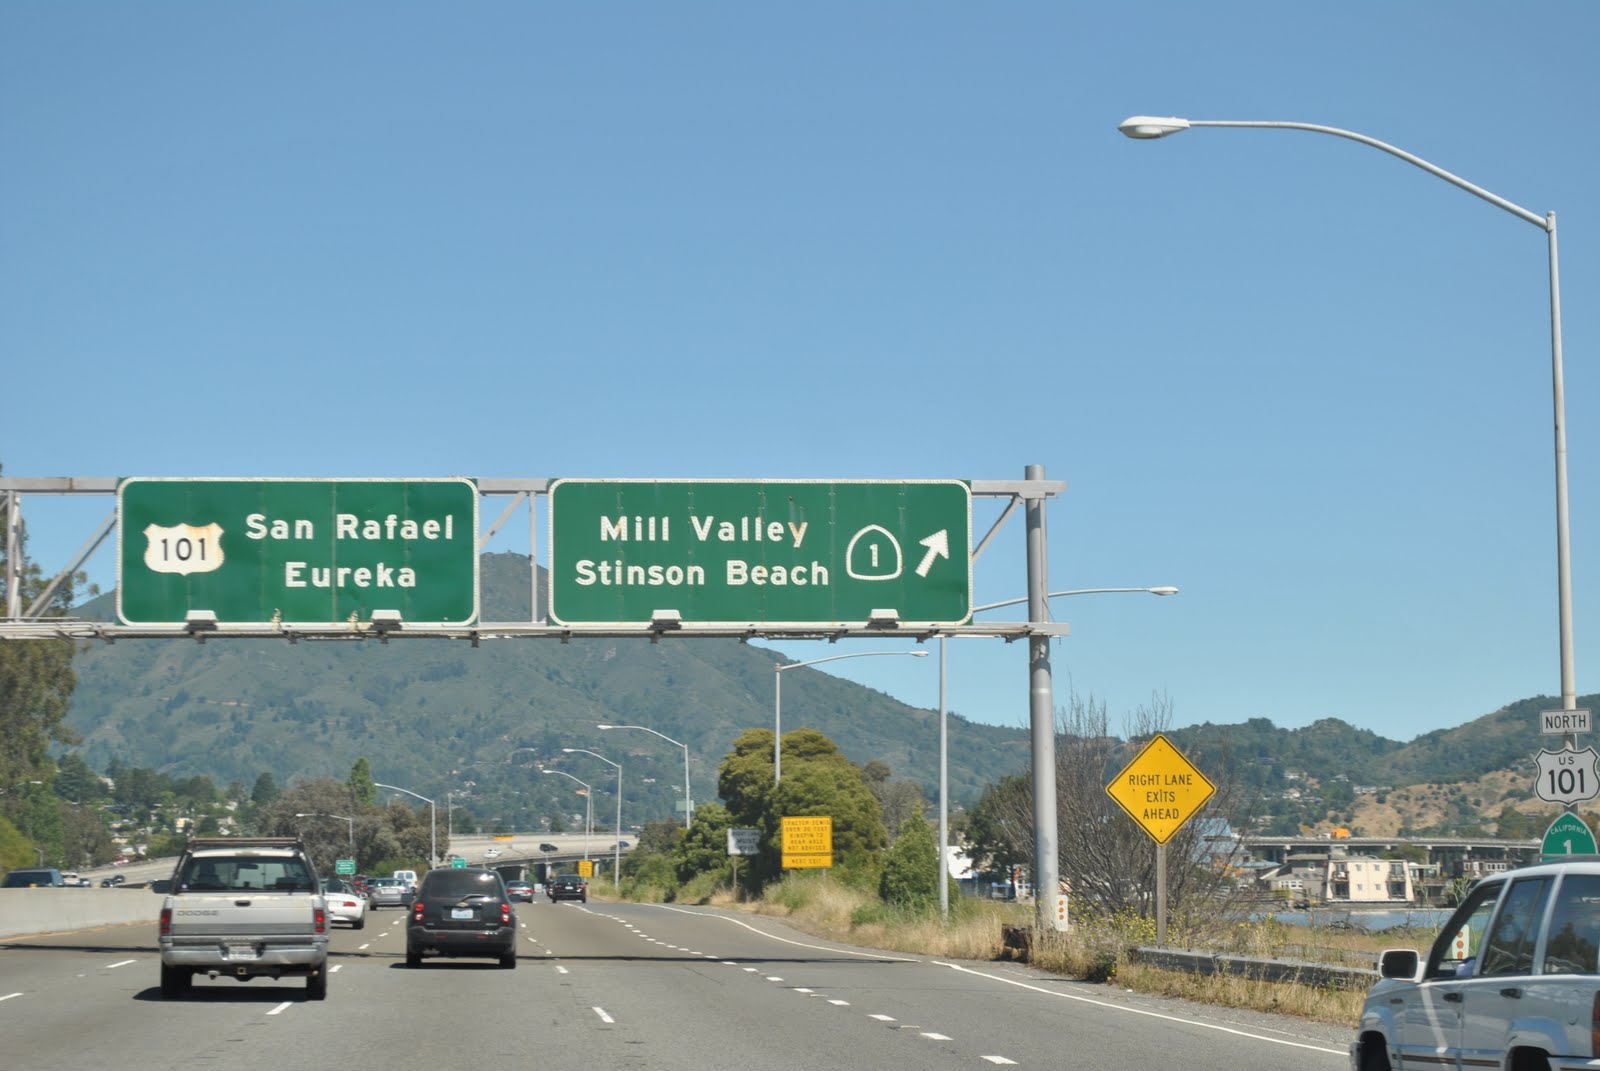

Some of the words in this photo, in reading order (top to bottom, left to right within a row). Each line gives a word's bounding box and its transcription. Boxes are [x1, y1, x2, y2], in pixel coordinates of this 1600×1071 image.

[245, 513, 314, 541] San
[336, 513, 454, 541] Rafael
[600, 515, 669, 542] Mill
[690, 515, 808, 549] Valley
[160, 537, 207, 562] 101
[868, 543, 879, 568] 1
[285, 561, 416, 588] Eureka
[574, 559, 705, 586] Stinson
[726, 559, 829, 586] Beach
[1545, 714, 1587, 729] NORTH
[1558, 756, 1575, 766] US
[1128, 774, 1161, 786] RIGHT
[1164, 774, 1193, 786] LANE
[1548, 767, 1585, 795] 101
[1146, 791, 1176, 803] EXITS
[1142, 808, 1180, 820] AHEAD
[1550, 824, 1587, 836] CALIFORNIA
[1563, 839, 1572, 855] 1
